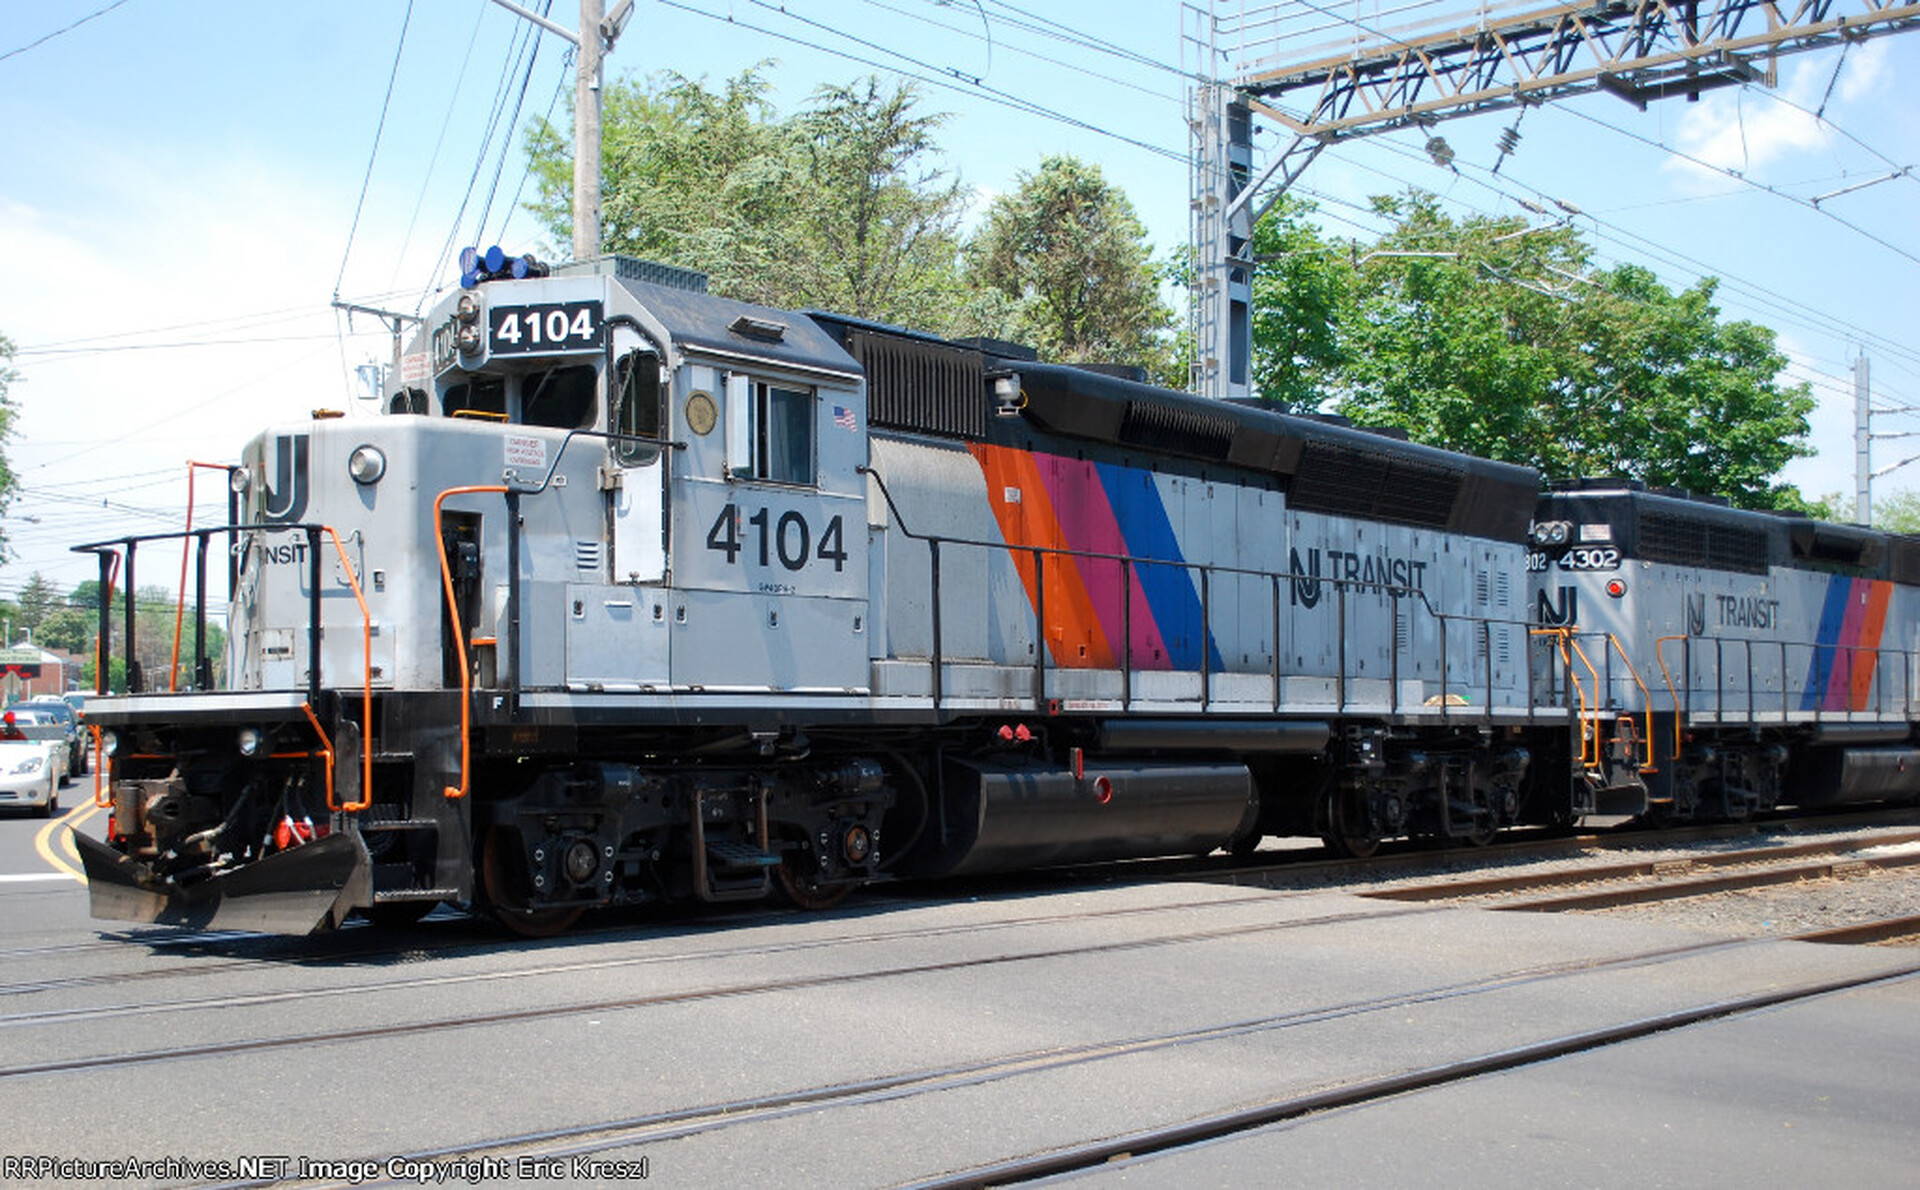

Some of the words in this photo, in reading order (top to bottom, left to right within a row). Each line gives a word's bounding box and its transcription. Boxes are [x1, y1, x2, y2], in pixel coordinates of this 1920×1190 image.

[497, 308, 595, 344] 4104
[706, 503, 848, 573] 4104
[265, 543, 309, 565] NSIT
[1526, 552, 1547, 571] 302
[1559, 549, 1619, 569] 4302
[1289, 546, 1320, 610] NJ
[1327, 550, 1427, 598] TRANSIT
[1716, 593, 1780, 630] TRANSIT
[493, 696, 504, 710] F
